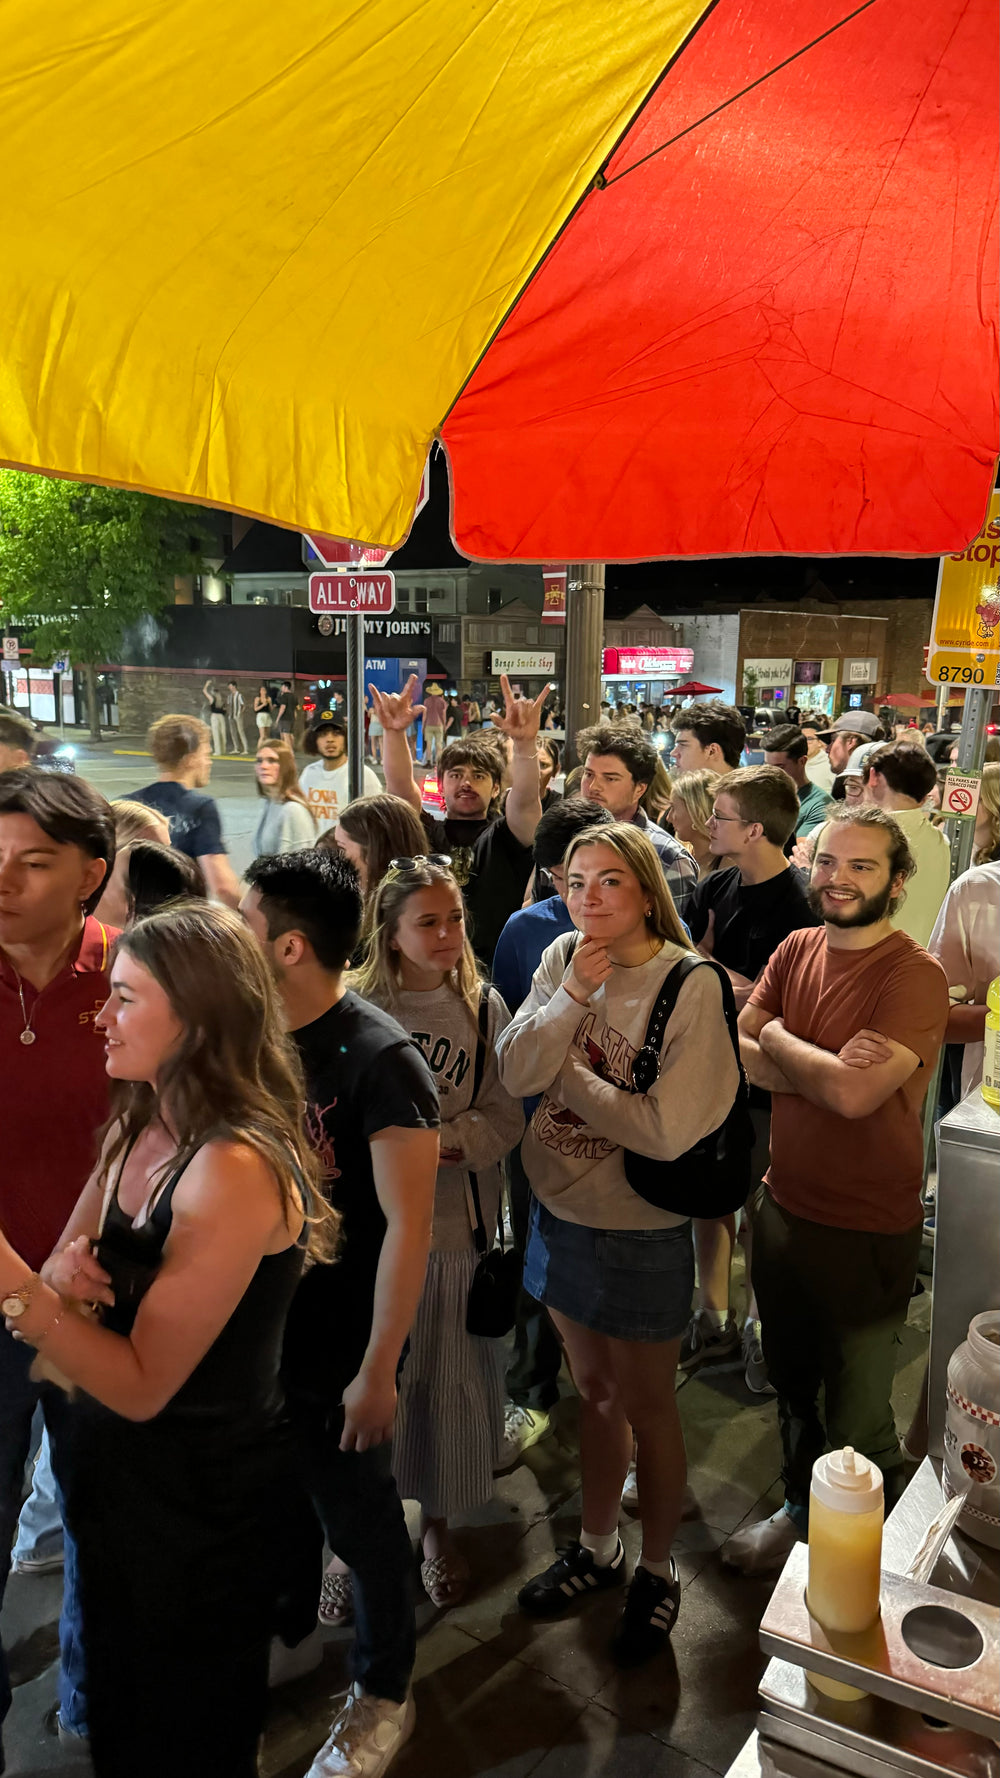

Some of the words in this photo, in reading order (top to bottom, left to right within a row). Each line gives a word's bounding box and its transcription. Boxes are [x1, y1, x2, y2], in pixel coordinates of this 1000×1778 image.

[950, 544, 1000, 569] top
[316, 582, 348, 605] ALL
[356, 581, 386, 605] WAY
[334, 618, 384, 636] JIMY
[385, 620, 431, 638] JOHN'S
[365, 659, 386, 671] ATM
[517, 656, 536, 668] Smoke
[539, 656, 553, 671] Shop
[938, 665, 985, 685] 8790
[310, 805, 338, 820] TATE
[410, 1031, 471, 1089] TON
